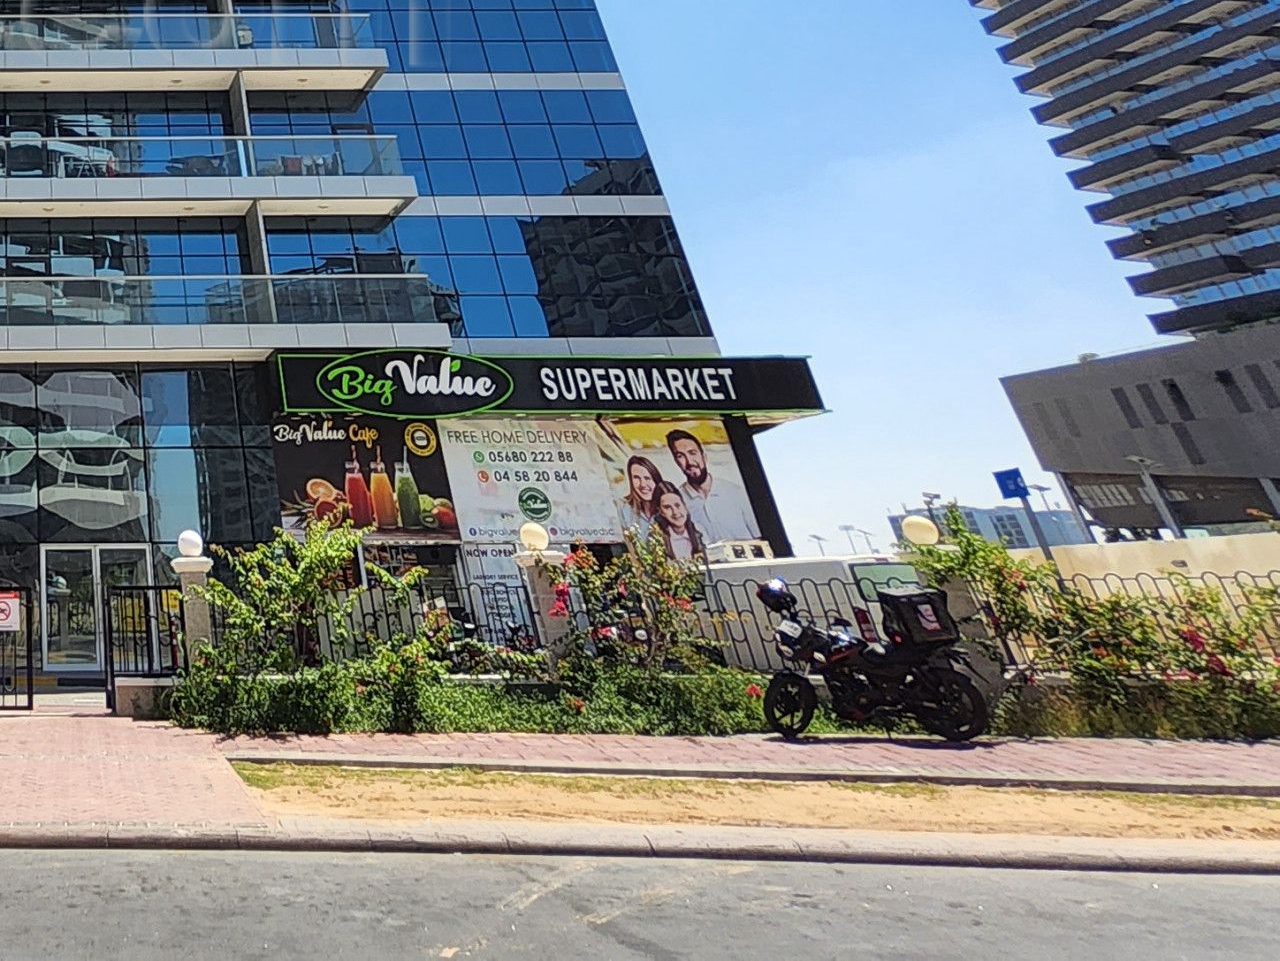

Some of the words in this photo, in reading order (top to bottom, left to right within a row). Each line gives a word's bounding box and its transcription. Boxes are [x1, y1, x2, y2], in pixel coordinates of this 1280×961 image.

[327, 366, 397, 406] Big
[384, 354, 496, 397] Value
[539, 367, 737, 400] SUPERMARKET
[273, 424, 305, 445] Big
[300, 420, 347, 442] Value
[348, 424, 379, 448] Cafe
[447, 430, 479, 443] FREE
[480, 430, 521, 443] HOME
[526, 430, 587, 443] DELIVERY
[488, 451, 528, 463] 05680
[530, 451, 555, 463] 222
[558, 451, 574, 463] 88
[493, 470, 510, 482] 04
[514, 470, 531, 482] 58
[534, 470, 550, 482] 20
[554, 470, 578, 482] 844
[478, 526, 520, 537] bigvalue
[466, 549, 488, 557] NOW
[490, 549, 514, 557] OPEN
